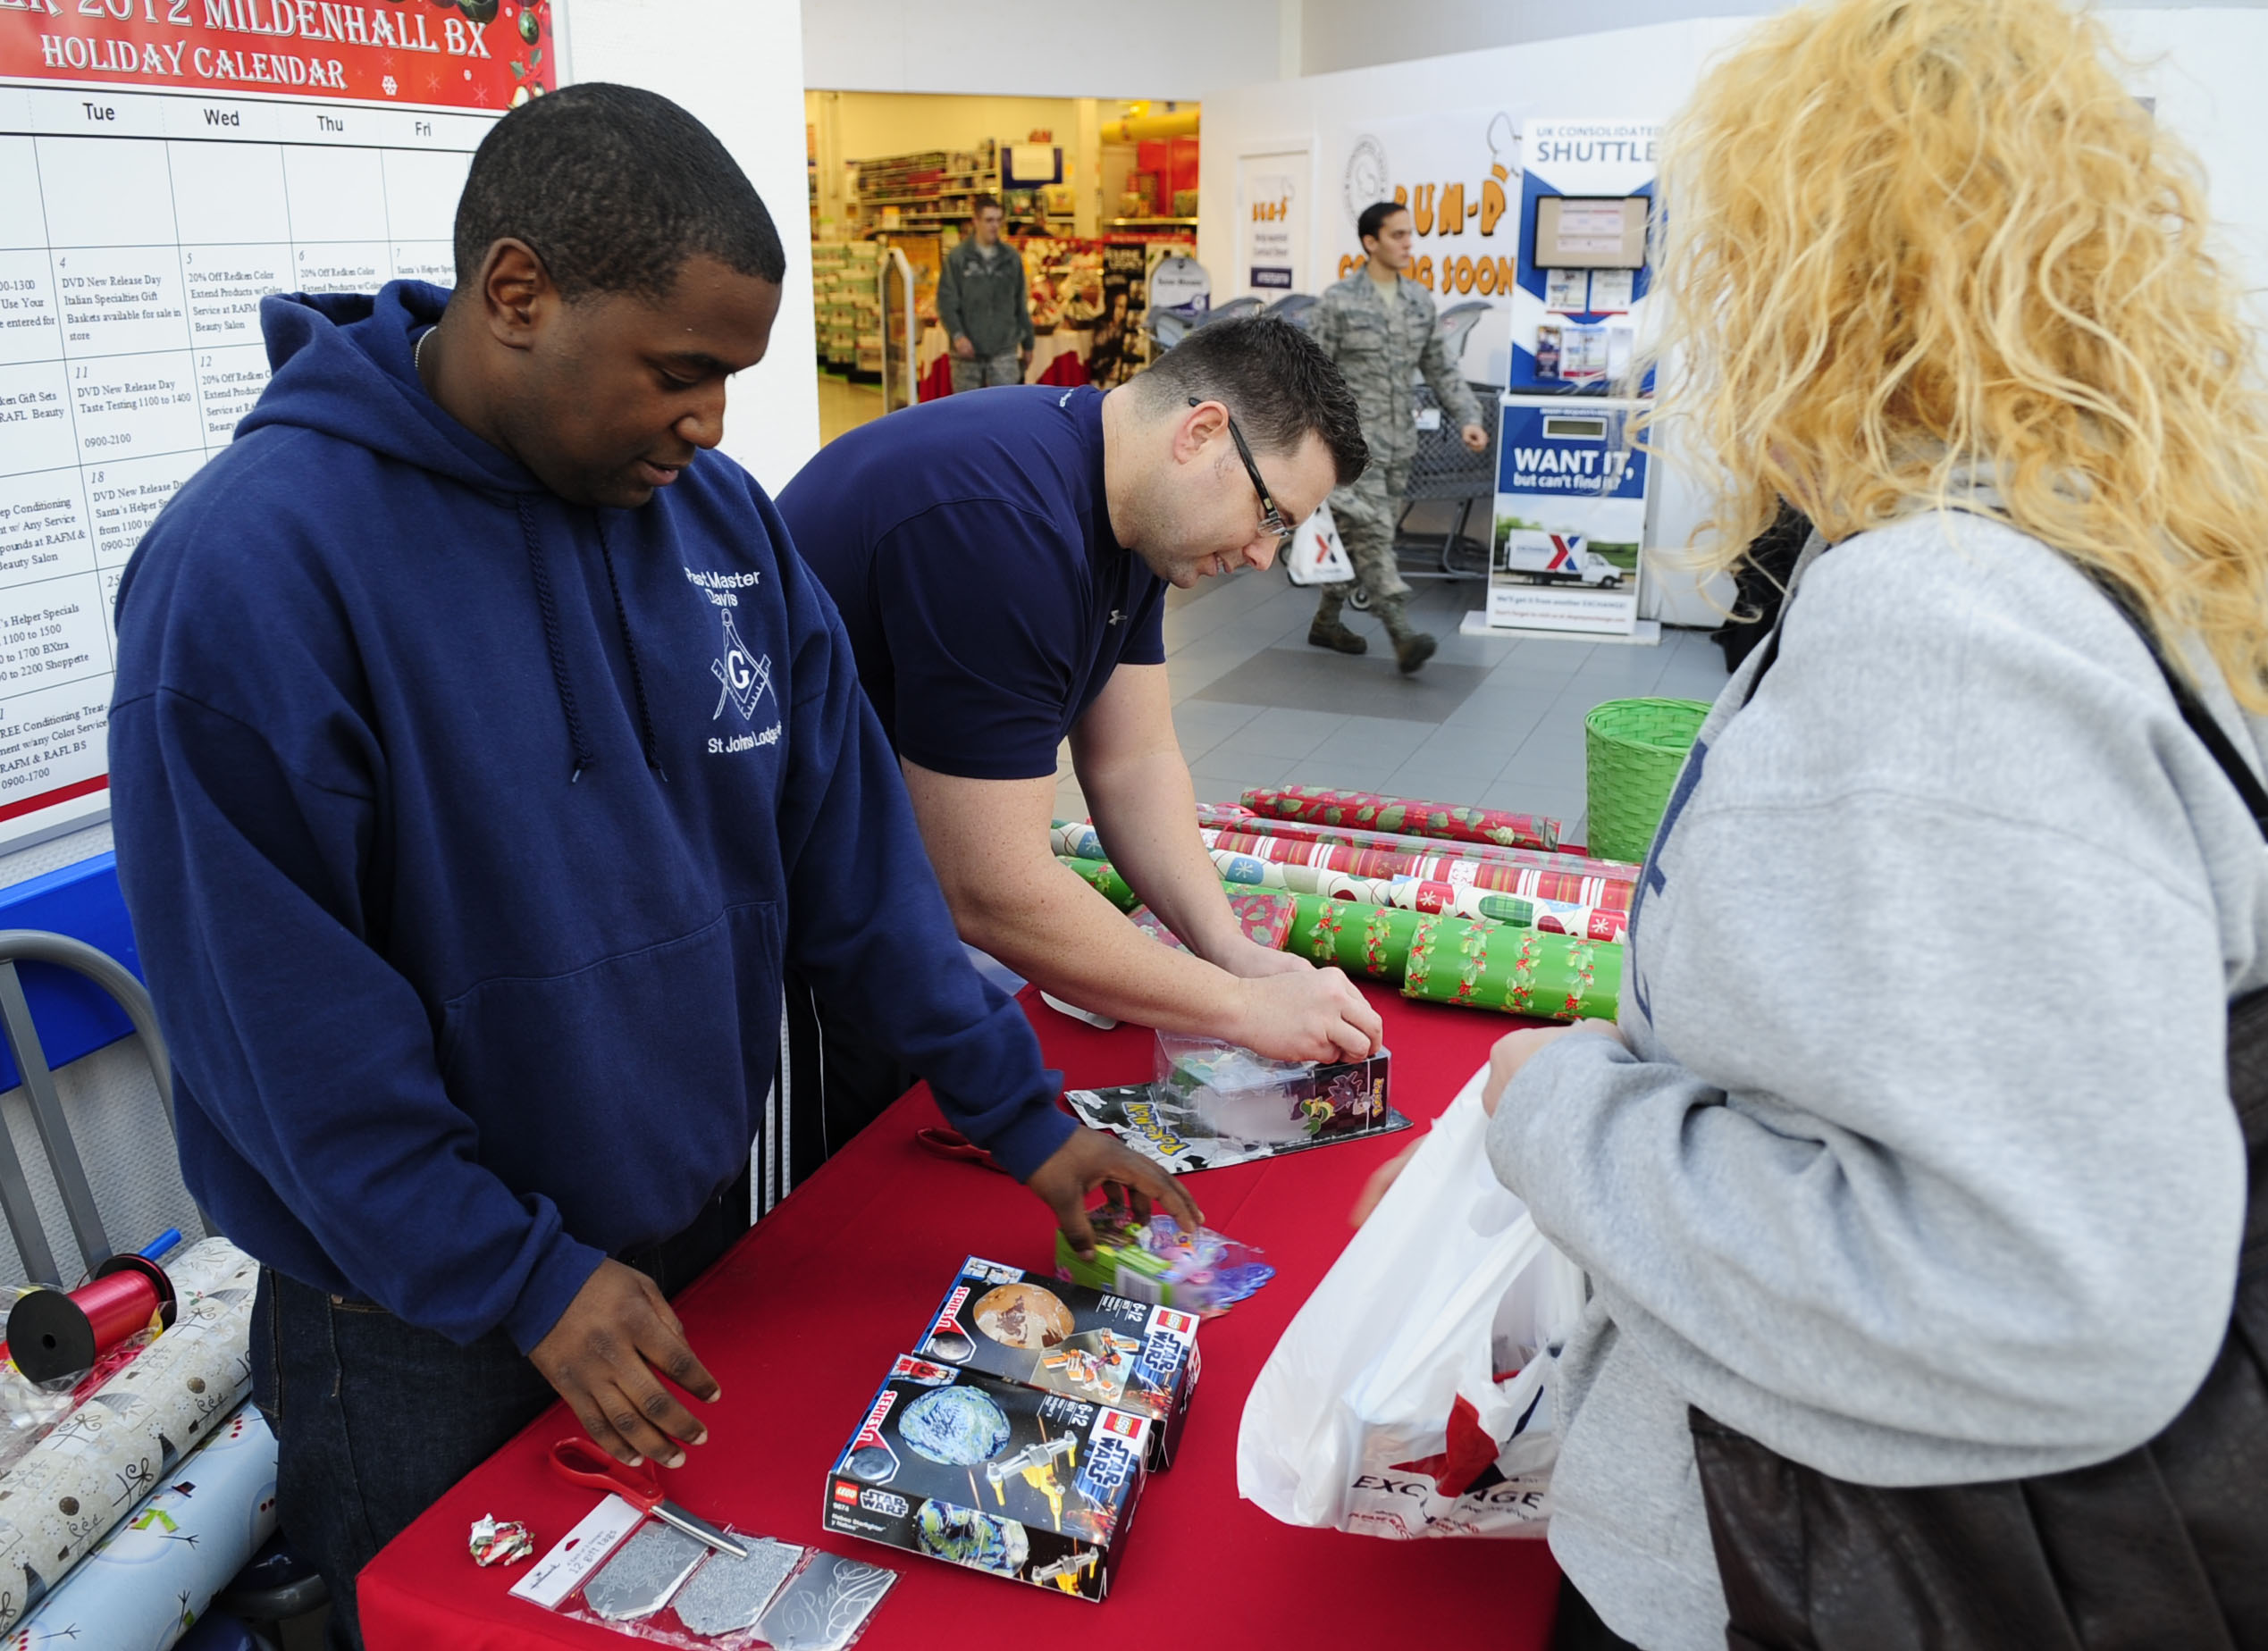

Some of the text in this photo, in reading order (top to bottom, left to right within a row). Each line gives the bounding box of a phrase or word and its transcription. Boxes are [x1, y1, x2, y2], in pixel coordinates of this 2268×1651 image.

[203, 0, 438, 54] MILDENHALL
[446, 18, 491, 59] BX
[41, 34, 349, 91] HOLIDAY CALENDAR
[82, 102, 115, 122] Tue
[204, 108, 240, 128] Wed
[316, 114, 344, 132] Thu
[415, 122, 432, 137] Fri
[1537, 140, 1658, 163] SHUTTLE
[59, 257, 65, 268] 4
[187, 252, 193, 264] 5
[298, 250, 305, 261] 6
[62, 274, 162, 288] DVD New Release Day
[208, 272, 222, 281] Off
[254, 270, 274, 280] Color
[1441, 255, 1514, 296] SOON
[64, 291, 157, 306] Italian Specialties Gift
[190, 287, 252, 298] Extend Products
[1, 298, 44, 309] Use Your
[193, 306, 221, 315] Service
[7, 315, 41, 328] entered
[43, 315, 55, 325] for
[67, 308, 181, 323] Baskets available for sale in
[195, 320, 246, 333] Beauty Salon
[70, 331, 90, 341] store
[200, 356, 212, 367] 12
[76, 366, 88, 379] 11
[221, 373, 235, 383] Off
[19, 393, 37, 403] Gift
[38, 391, 56, 401] Sets
[77, 380, 175, 398] DVD New Release Day
[80, 392, 191, 414] Taste Testing 1100 to 1400
[206, 405, 233, 416] Service
[32, 408, 64, 419] Beauty
[84, 432, 131, 448] 0900-2100
[1514, 448, 1634, 481] WANT IT,
[91, 471, 105, 483] 18
[1513, 472, 1537, 487] but
[1538, 474, 1572, 489] can't
[1573, 474, 1601, 490] find
[93, 480, 185, 502] DVD New Release Da
[13, 498, 72, 515] Conditioning
[129, 501, 156, 514] Helper
[23, 521, 42, 532] Any
[45, 514, 75, 527] Service
[99, 519, 153, 535] from 1100 to
[35, 538, 43, 547] at
[46, 530, 76, 545] RAFM
[78, 529, 86, 540] &
[101, 535, 144, 551] 0900-210
[32, 552, 58, 565] Salon
[107, 574, 121, 587] 25
[684, 566, 760, 589] Past Master
[704, 588, 738, 607] Davis
[11, 614, 41, 625] Helper
[43, 604, 79, 621] Specials
[4, 624, 62, 645] 1100 to 1500
[6, 654, 15, 663] to
[18, 646, 40, 659] 1700
[43, 641, 69, 654] BXtra
[10, 671, 19, 680] to
[21, 663, 43, 676] 2200
[46, 653, 89, 670] Shoppette
[727, 650, 750, 689] G
[23, 711, 80, 733] Conditioning
[82, 704, 108, 716] Treat-
[51, 729, 75, 741] Color
[77, 719, 107, 734] Service
[708, 737, 724, 753] St
[726, 733, 754, 752] Johns
[32, 754, 40, 764] &
[44, 745, 71, 761] RAFL
[2, 767, 50, 790] 0900-1700
[1128, 1303, 1147, 1322] 6-12
[1145, 1330, 1170, 1370] WARS
[1158, 1333, 1181, 1371] STAR
[865, 1390, 896, 1429] SERIES
[1071, 1404, 1094, 1427] 6-12
[1088, 1437, 1117, 1485] WARS
[1102, 1438, 1130, 1486] STAR
[862, 1489, 907, 1509] STAR
[1351, 1475, 1544, 1519] EXCNGE
[862, 1498, 905, 1516] WARS
